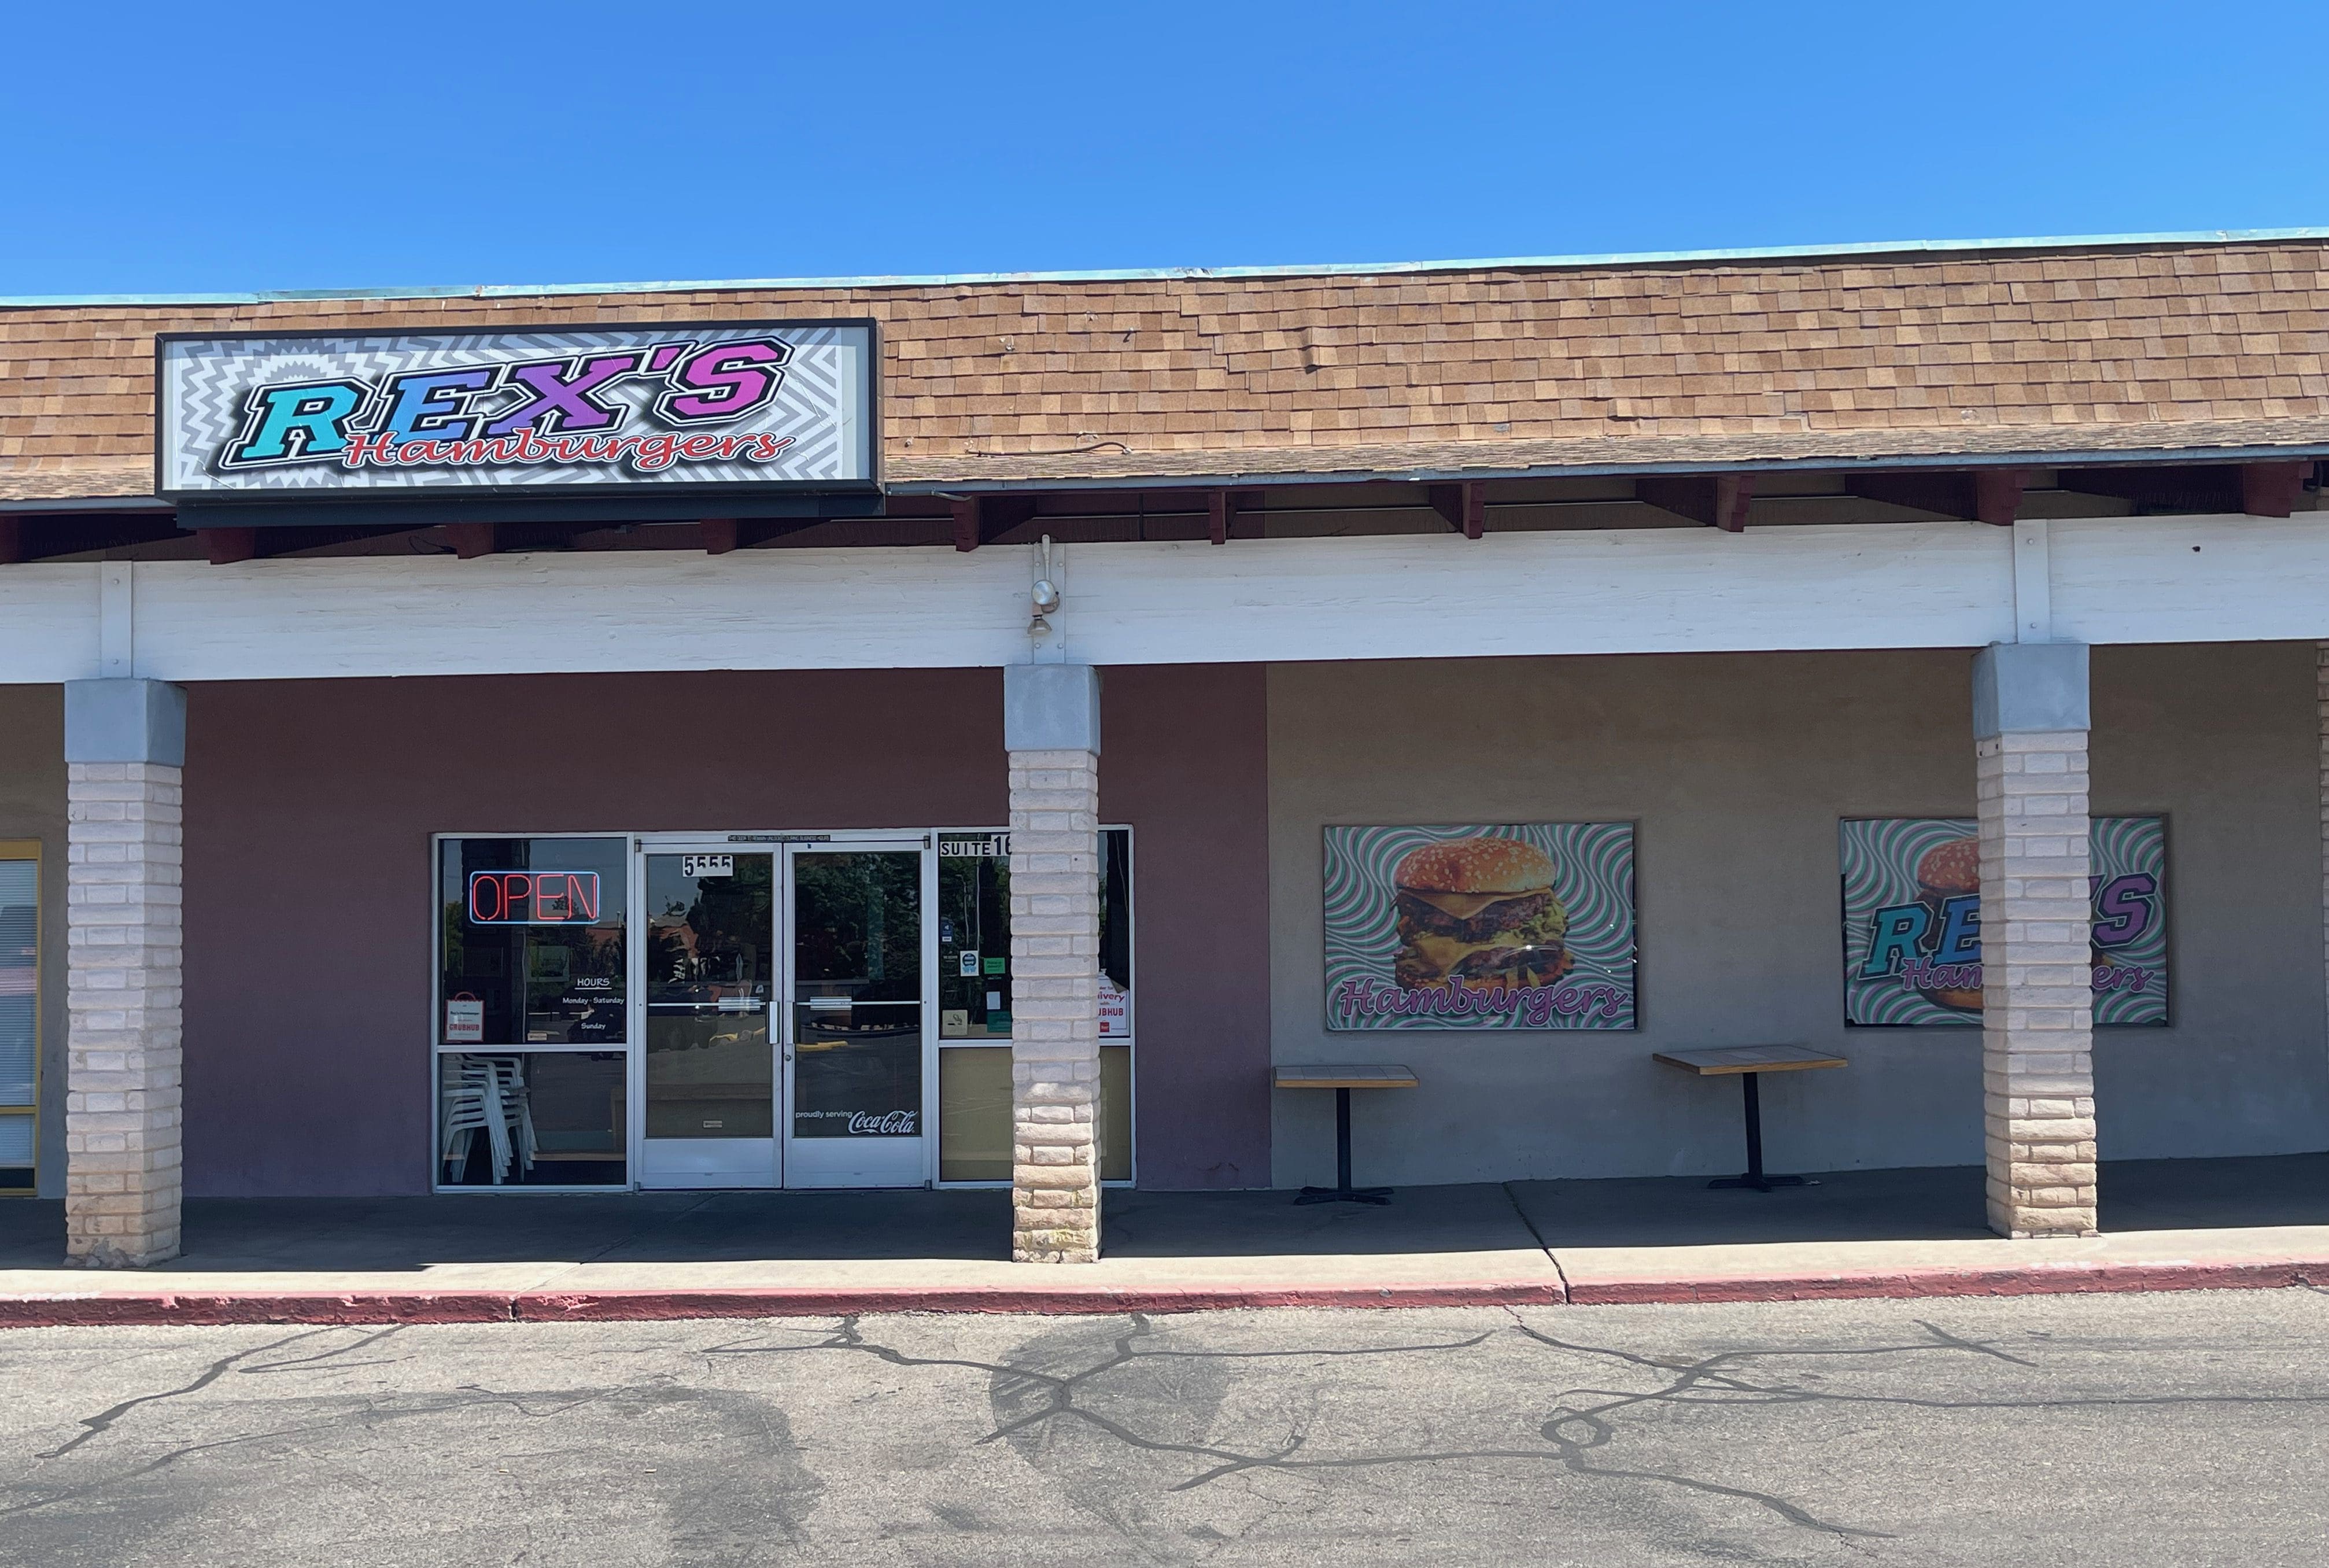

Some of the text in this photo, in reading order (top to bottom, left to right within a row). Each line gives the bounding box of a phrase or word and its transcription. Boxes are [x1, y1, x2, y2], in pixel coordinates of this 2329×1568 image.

[224, 336, 795, 467] REX'S
[345, 428, 795, 471] Hamburgers
[941, 842, 991, 855] SUITE
[684, 856, 730, 876] 5555
[472, 874, 597, 920] OPEN
[1857, 872, 2158, 980] RE'S
[577, 978, 610, 986] HOURS
[1900, 956, 2154, 993] Hamers
[593, 997, 625, 1005] Saturday
[1098, 1008, 1124, 1016] UBHUB
[1340, 975, 1628, 1026] Hamburgers
[795, 1110, 918, 1134] proudly serving Coca-Cola
